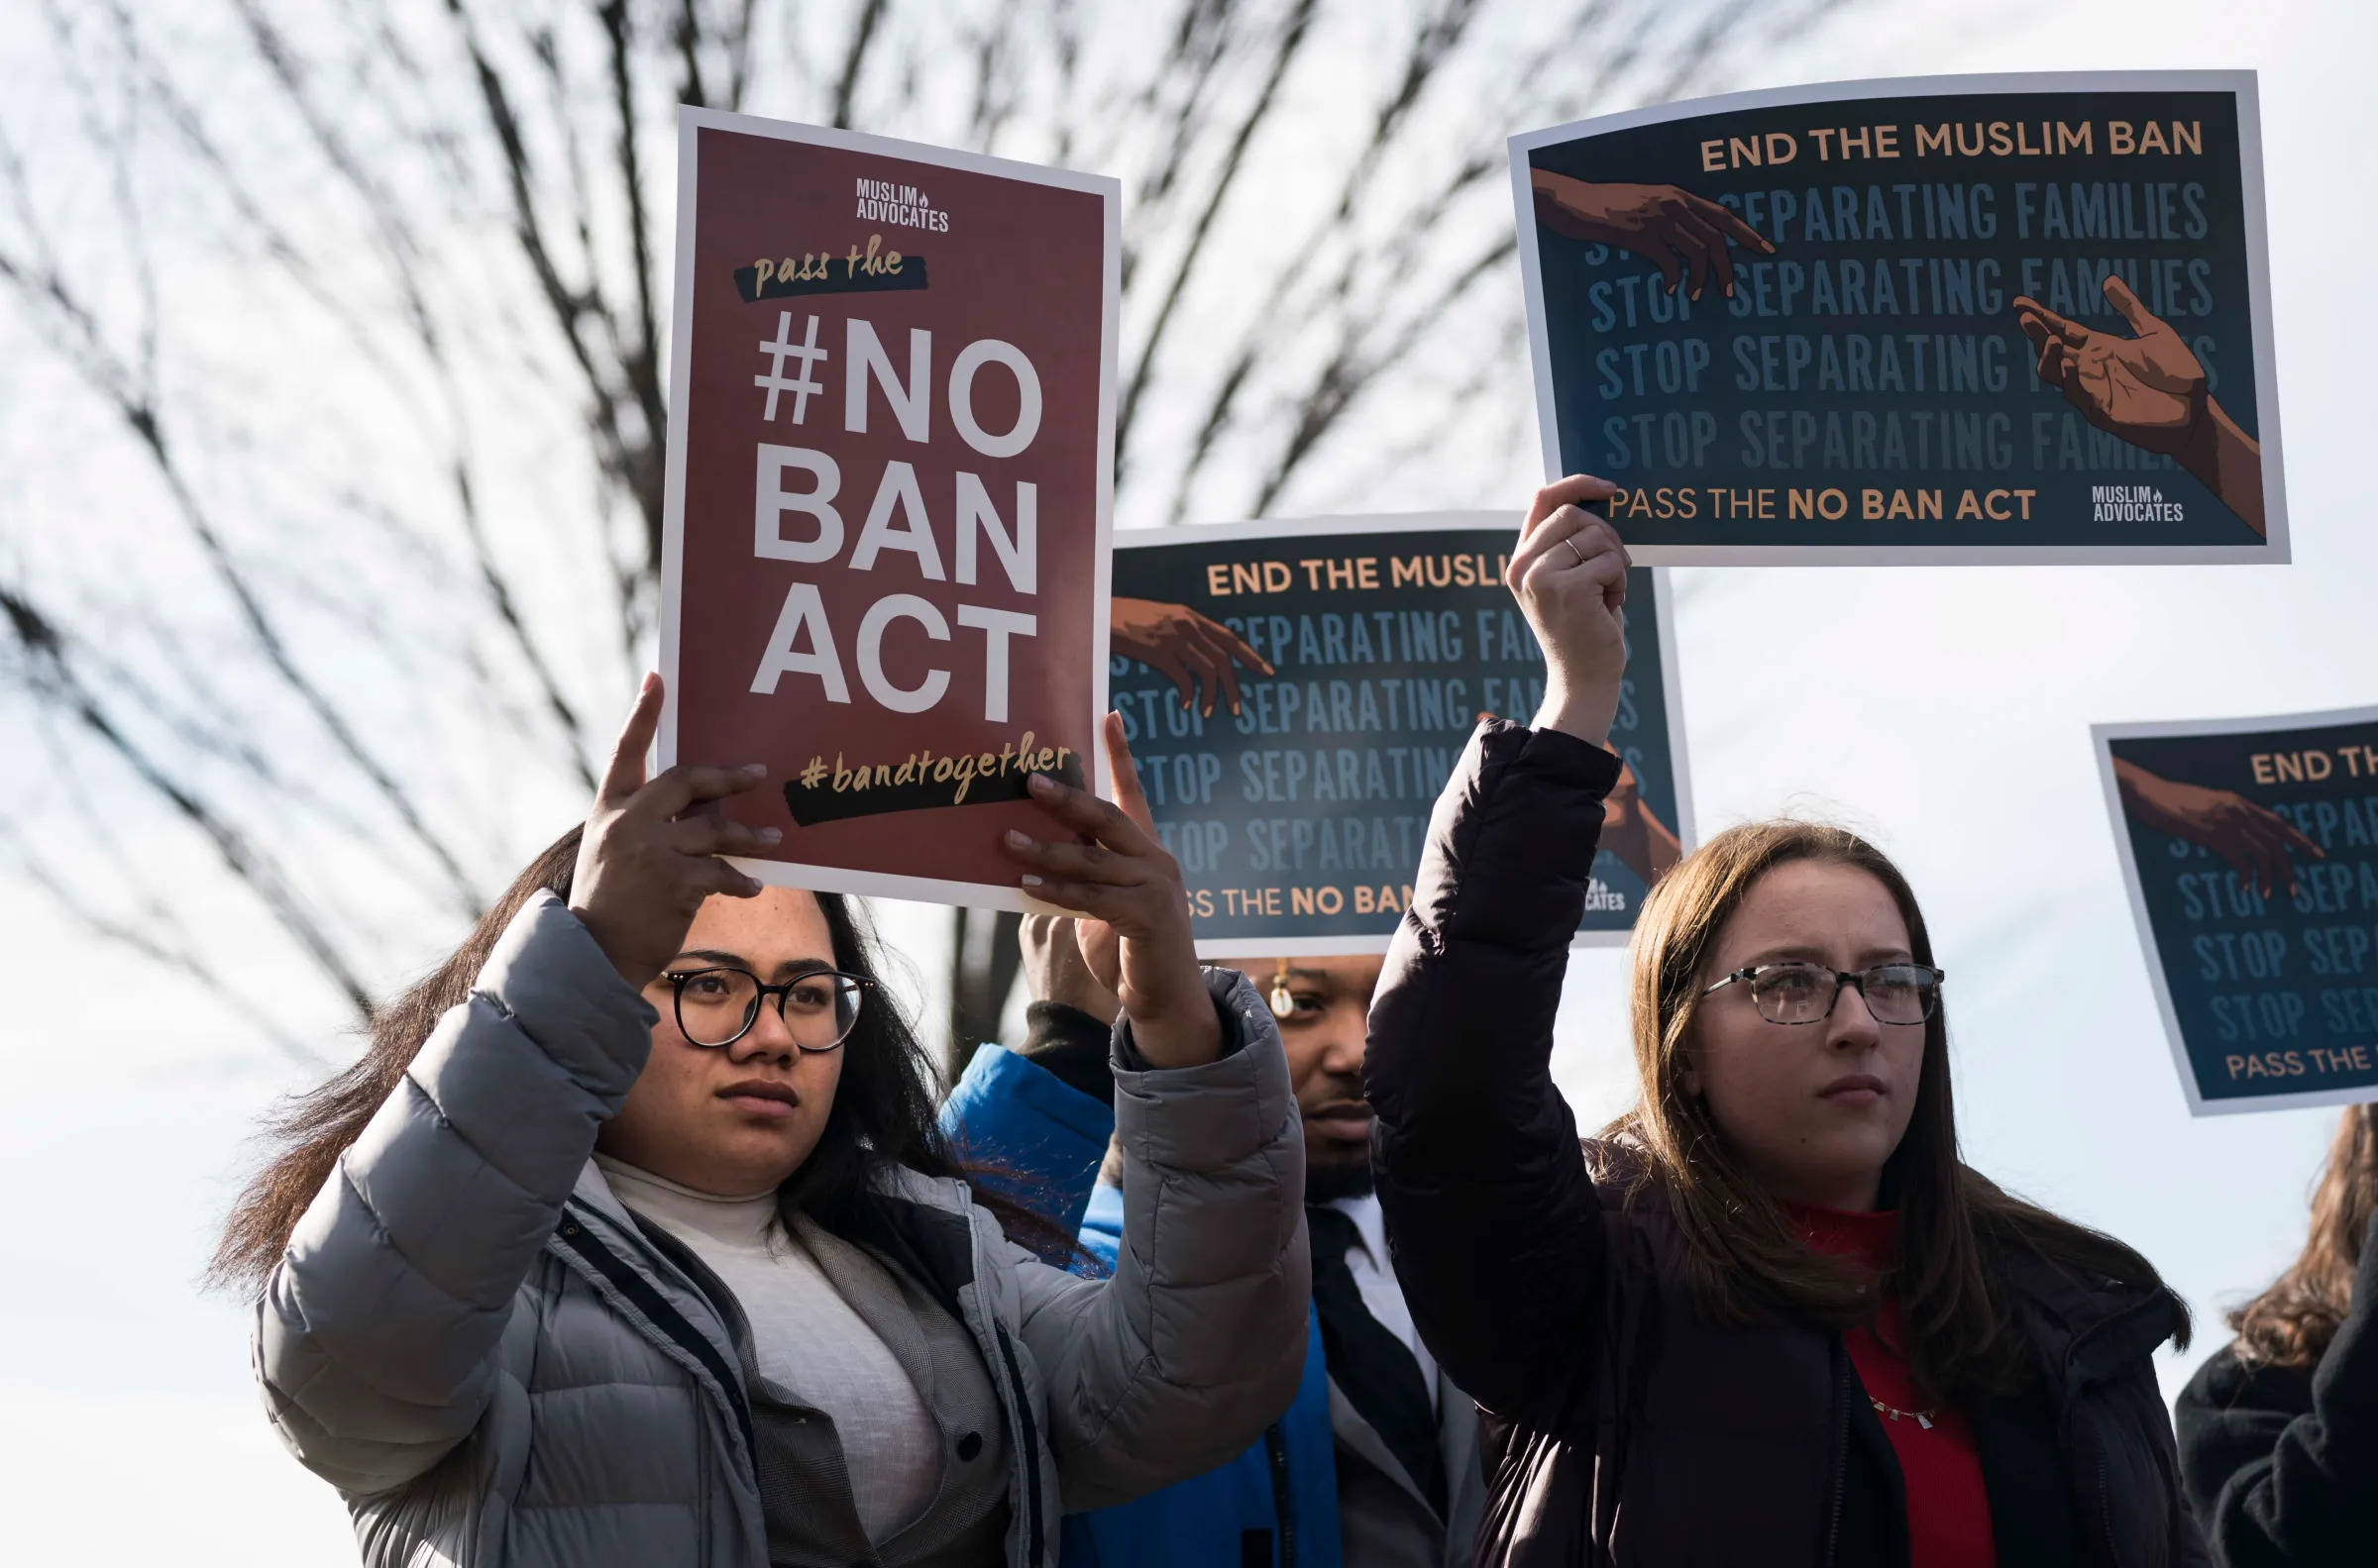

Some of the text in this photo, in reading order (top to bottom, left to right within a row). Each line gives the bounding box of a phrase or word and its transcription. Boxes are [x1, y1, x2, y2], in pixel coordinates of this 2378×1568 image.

[1700, 120, 2203, 172] END THE MUSLIM BAN
[856, 177, 918, 207] MUSLIM
[856, 198, 949, 233] ADVOCATES
[2014, 181, 2209, 240] FAMILIES
[754, 234, 904, 298] pass the
[1588, 268, 1690, 334] STO
[754, 310, 1042, 458] #NO
[1595, 338, 1711, 400] STOP
[1733, 333, 2008, 394] SEPARATING
[1603, 410, 1718, 470] STOP
[1739, 409, 2012, 470] SEPARATING
[754, 442, 1036, 594] BAN
[1608, 487, 2036, 521] PASS THE NO BAN ACT
[2092, 485, 2152, 503] MUSLIM
[2094, 502, 2184, 522] ADVOCATES
[1207, 553, 1507, 596] END THE MUSLI
[749, 581, 1036, 723] ACT
[1113, 683, 1203, 741] STO
[800, 731, 1071, 804] #bandtogether
[1133, 752, 1222, 805] TOP
[2250, 749, 2332, 785] END
[1246, 815, 1427, 873] SEPARAT
[1222, 888, 1282, 916] THE
[1291, 886, 1344, 916] NO
[2177, 868, 2266, 920] STO
[2193, 925, 2378, 982] STOP SEP
[2210, 992, 2306, 1041] STOP
[2225, 1045, 2372, 1081] PASS THE
